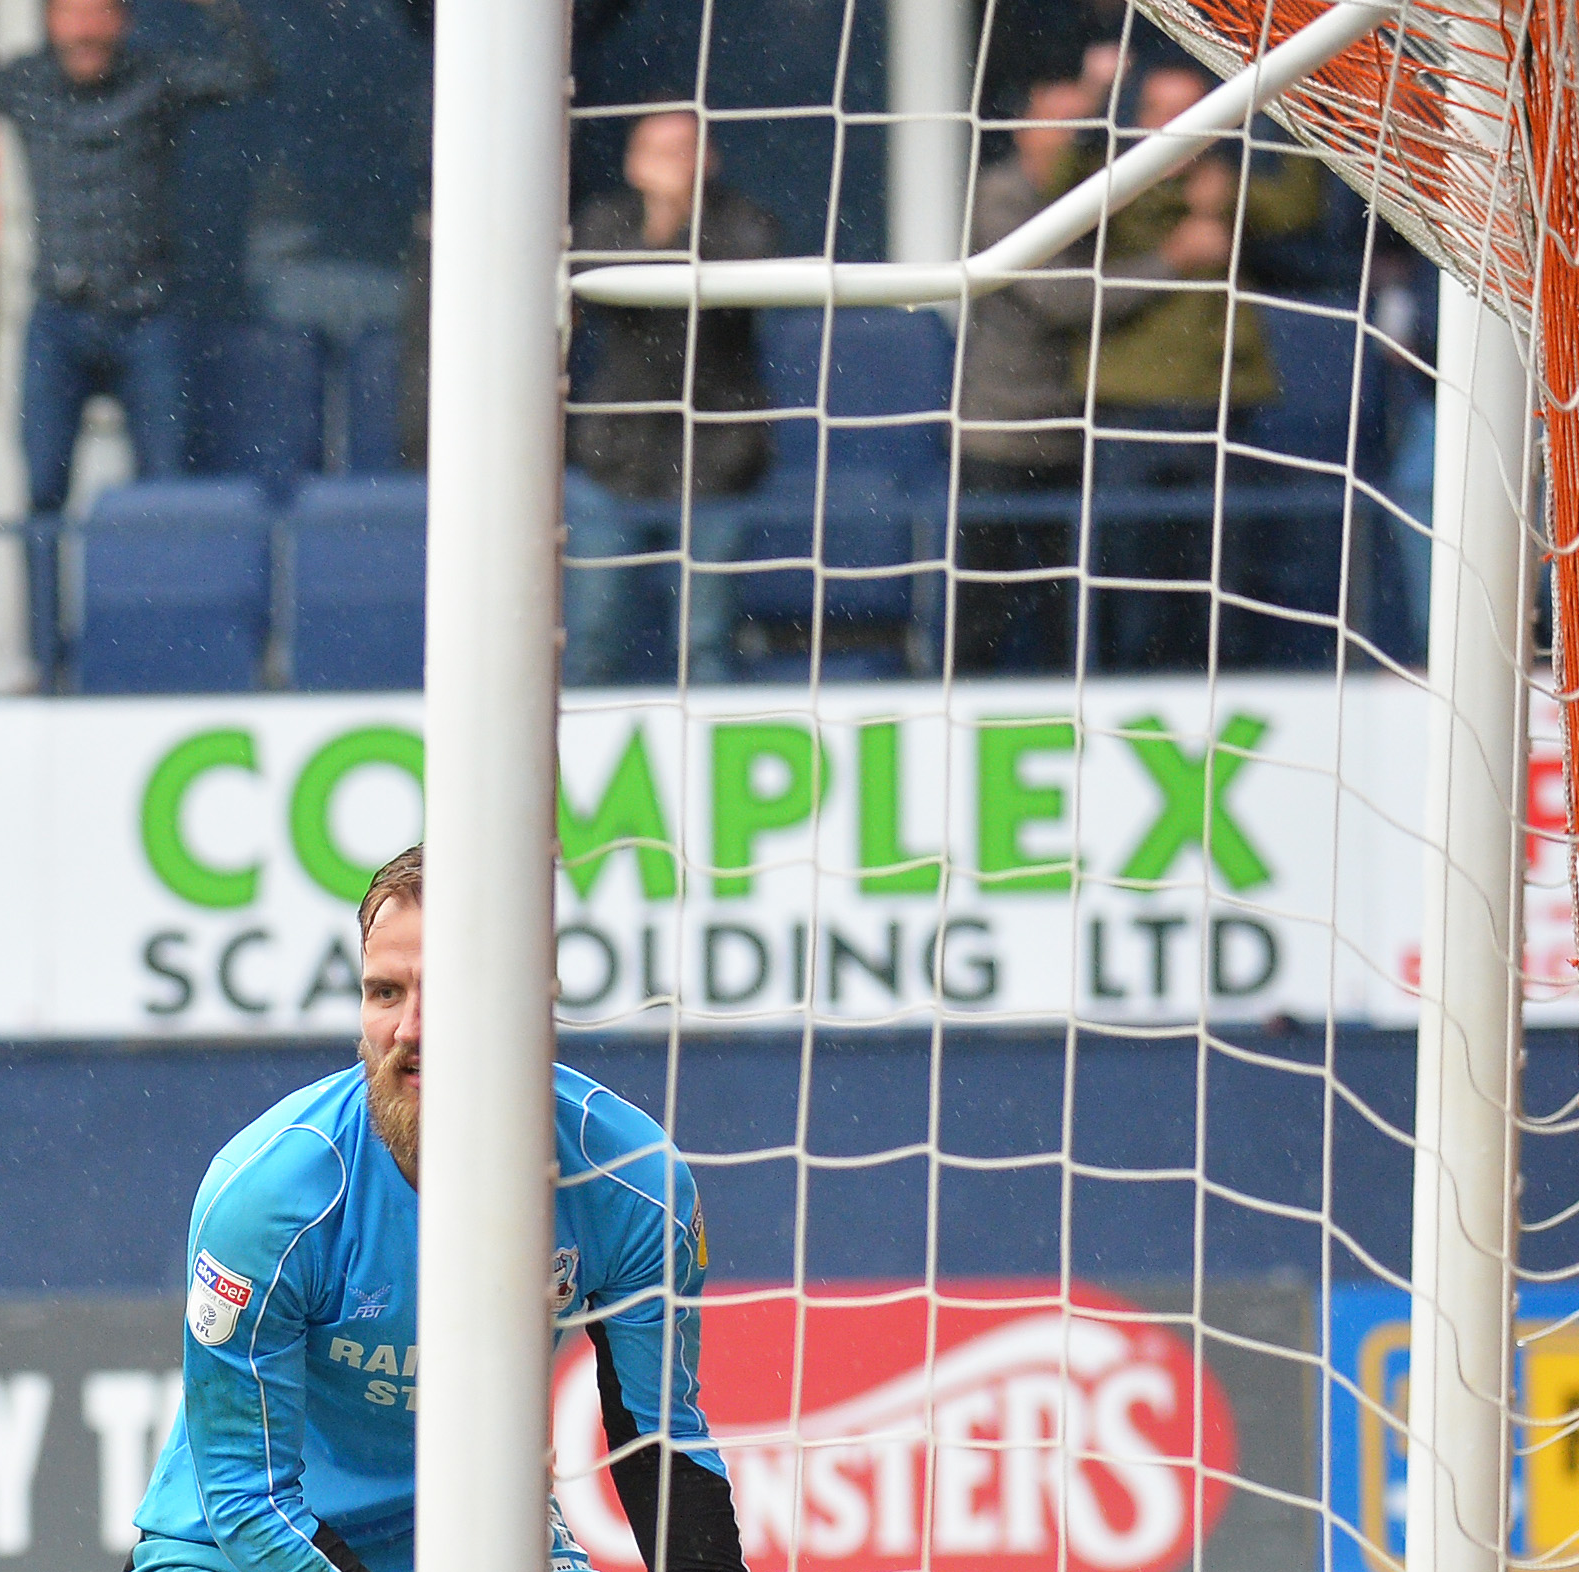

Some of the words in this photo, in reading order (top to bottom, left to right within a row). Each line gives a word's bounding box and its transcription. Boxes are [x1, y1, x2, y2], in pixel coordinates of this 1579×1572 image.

[138, 708, 1274, 911] COMPLEX
[142, 918, 1001, 1016] SCAOLDING
[1091, 914, 1279, 999] LTD
[195, 1320, 211, 1339] EFL
[196, 1261, 217, 1286] sky
[217, 1278, 246, 1302] bet
[81, 1368, 185, 1554] T
[550, 1340, 1185, 1572] NSTERS
